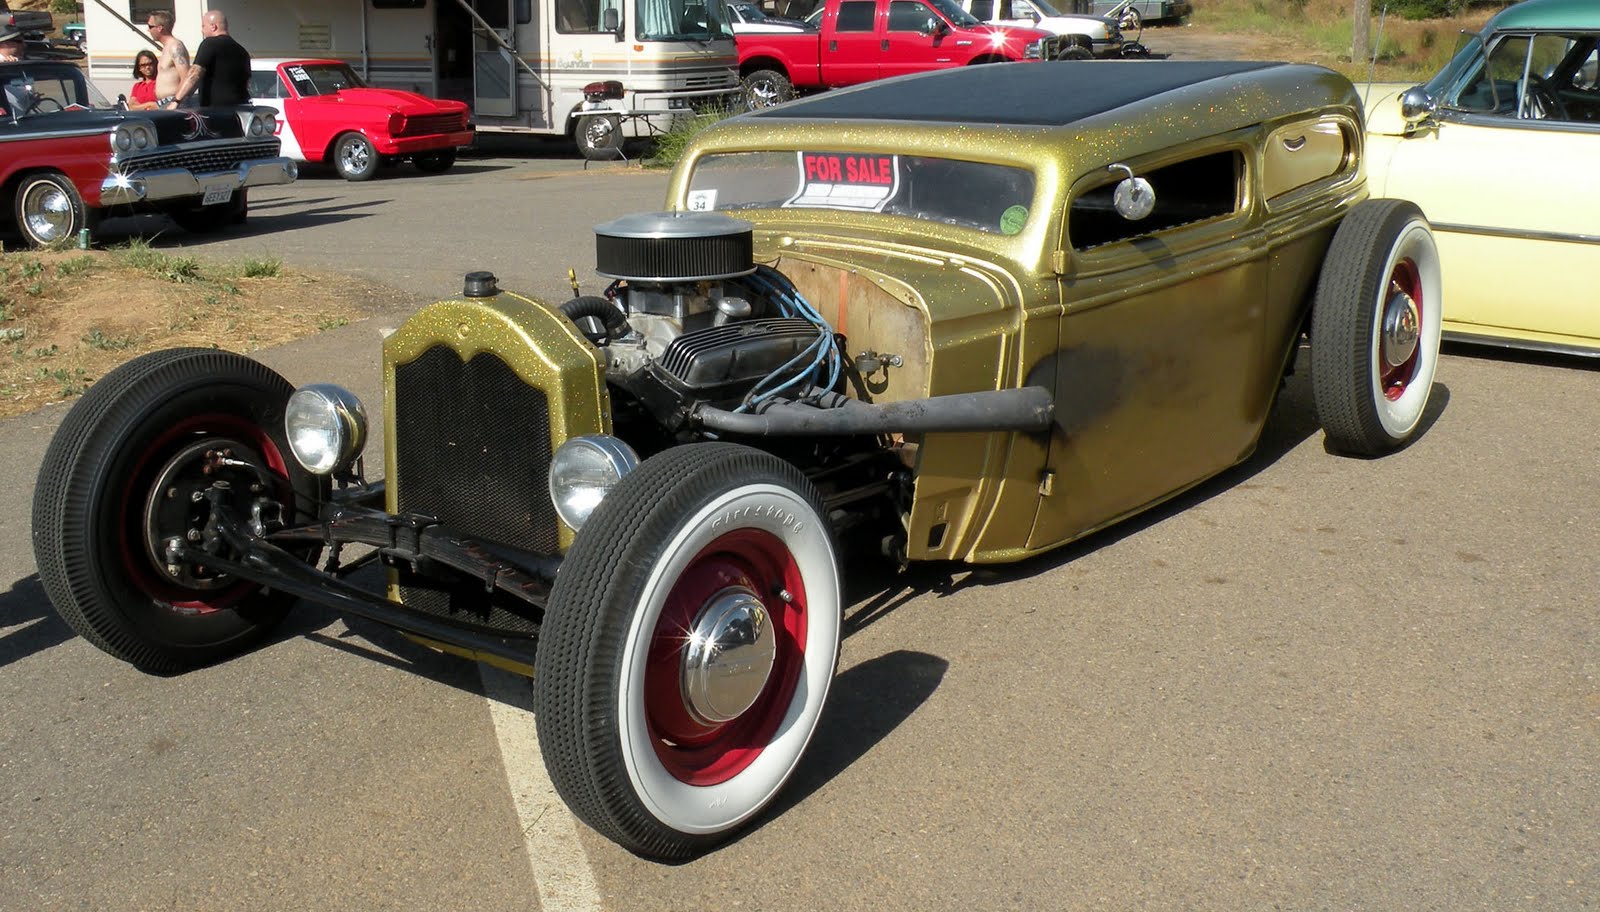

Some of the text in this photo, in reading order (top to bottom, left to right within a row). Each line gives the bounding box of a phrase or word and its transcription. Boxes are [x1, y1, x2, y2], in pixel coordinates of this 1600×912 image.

[804, 155, 892, 185] FOR SALE
[693, 201, 706, 211] 34
